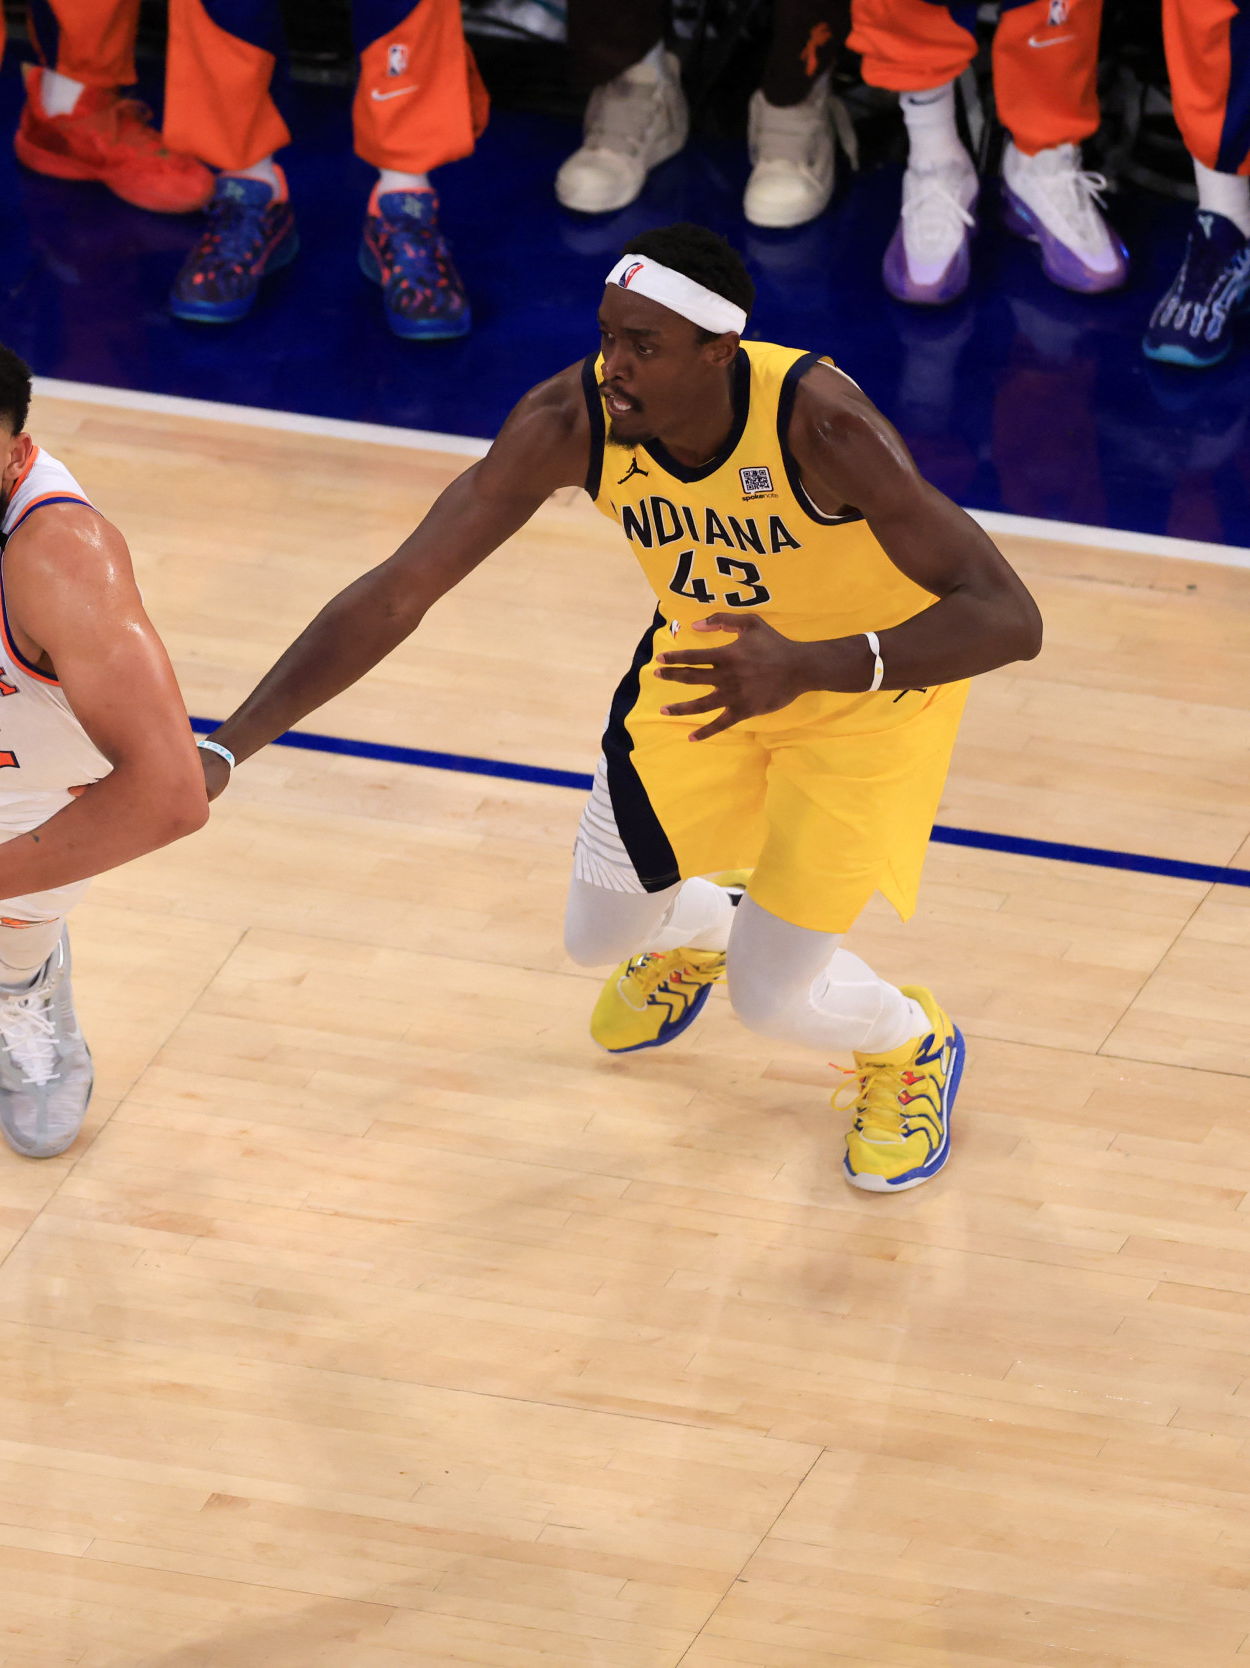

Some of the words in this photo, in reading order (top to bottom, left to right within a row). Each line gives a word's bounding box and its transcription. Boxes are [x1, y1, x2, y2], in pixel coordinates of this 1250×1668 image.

[610, 495, 803, 555] NDIANA
[742, 493, 779, 502] spokenote
[668, 549, 771, 607] 43
